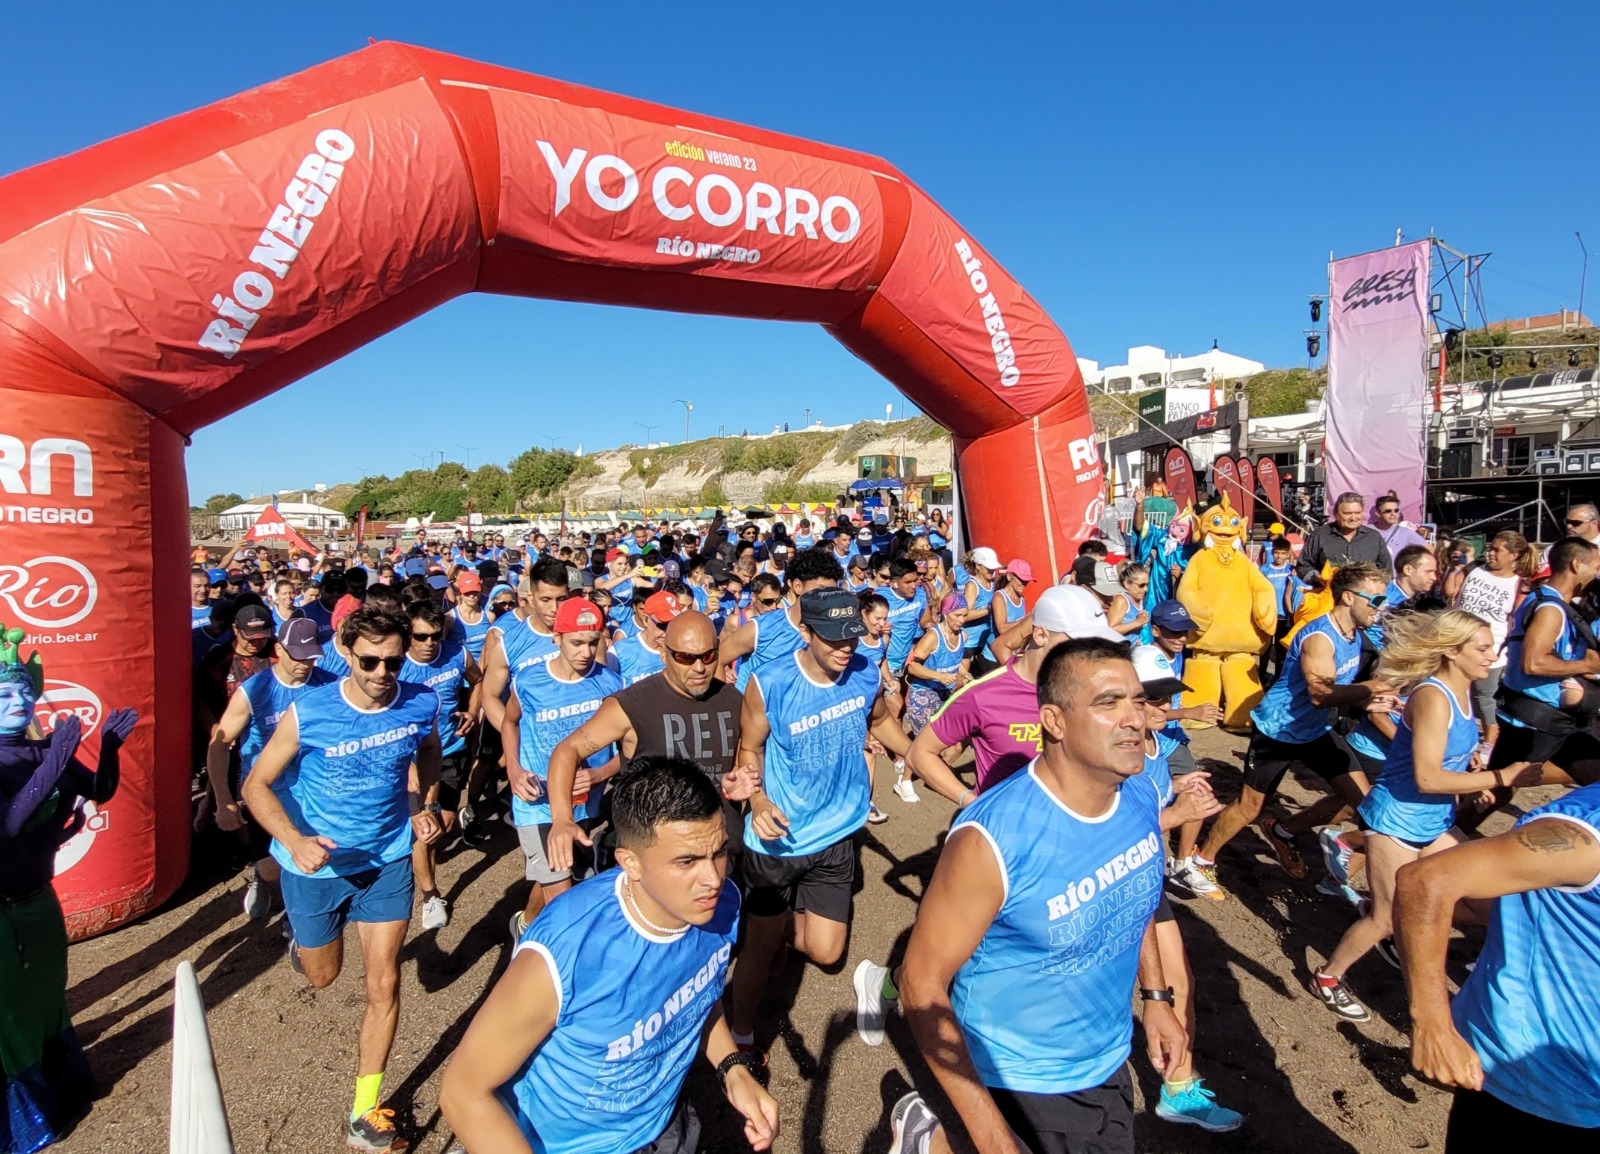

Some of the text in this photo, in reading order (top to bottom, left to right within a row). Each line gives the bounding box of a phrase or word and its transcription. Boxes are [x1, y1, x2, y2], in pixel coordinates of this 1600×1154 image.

[664, 140, 757, 172] edición verano 23
[536, 140, 861, 243] YO CORRO
[198, 128, 355, 360] RÍO NEGRO
[656, 236, 761, 264] RÍO NEGRO
[954, 238, 1020, 388] RÍO NEGRO
[1168, 402, 1200, 412] BANCO
[254, 522, 286, 537] RN
[829, 606, 855, 619] D&G
[559, 699, 603, 719] NEGR
[788, 695, 866, 736] RÍO NEGRO
[325, 723, 419, 757] RÍO NEGRO
[1046, 831, 1160, 921] RÍO NEGRO
[1048, 905, 1101, 946] RÍO
[605, 942, 731, 1061] RÍO NEGRO
